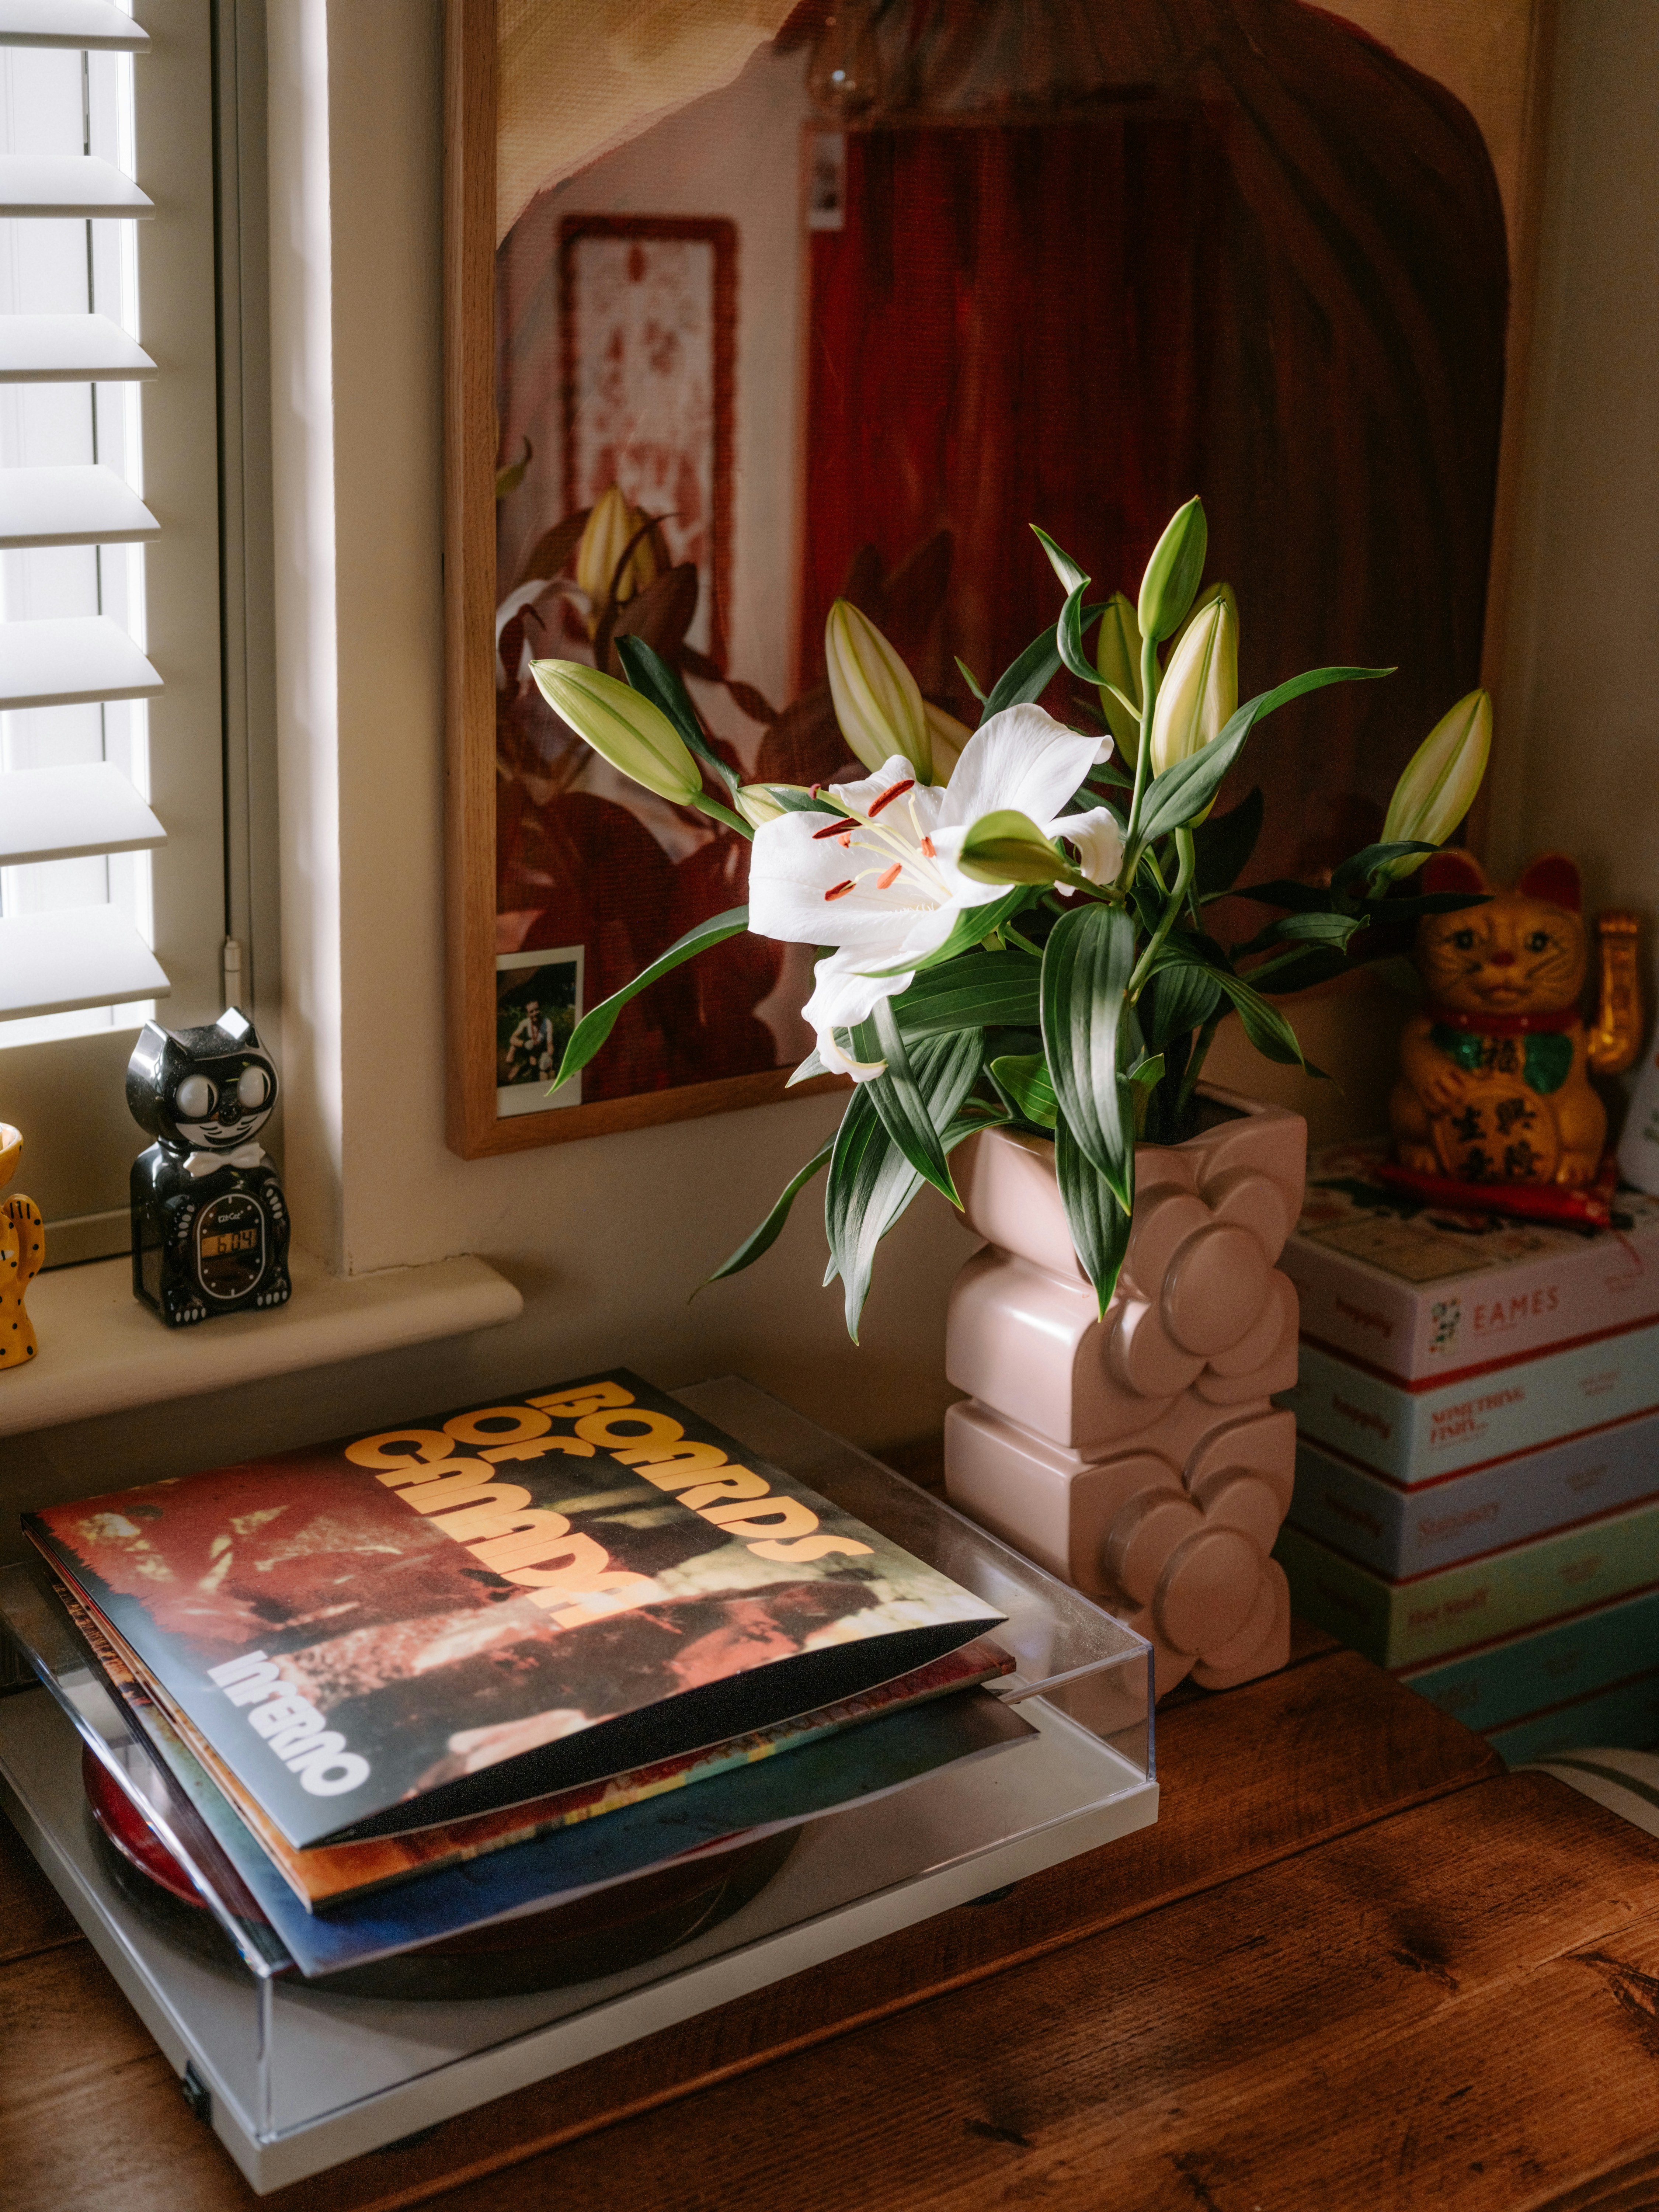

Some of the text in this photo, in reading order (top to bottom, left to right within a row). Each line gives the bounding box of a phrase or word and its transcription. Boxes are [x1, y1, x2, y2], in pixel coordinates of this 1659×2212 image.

[1473, 1287, 1559, 1330] EAMES
[1430, 1385, 1526, 1424] SOMETHING
[525, 1381, 874, 1562] BOARDS
[345, 1429, 659, 1629] CANADA
